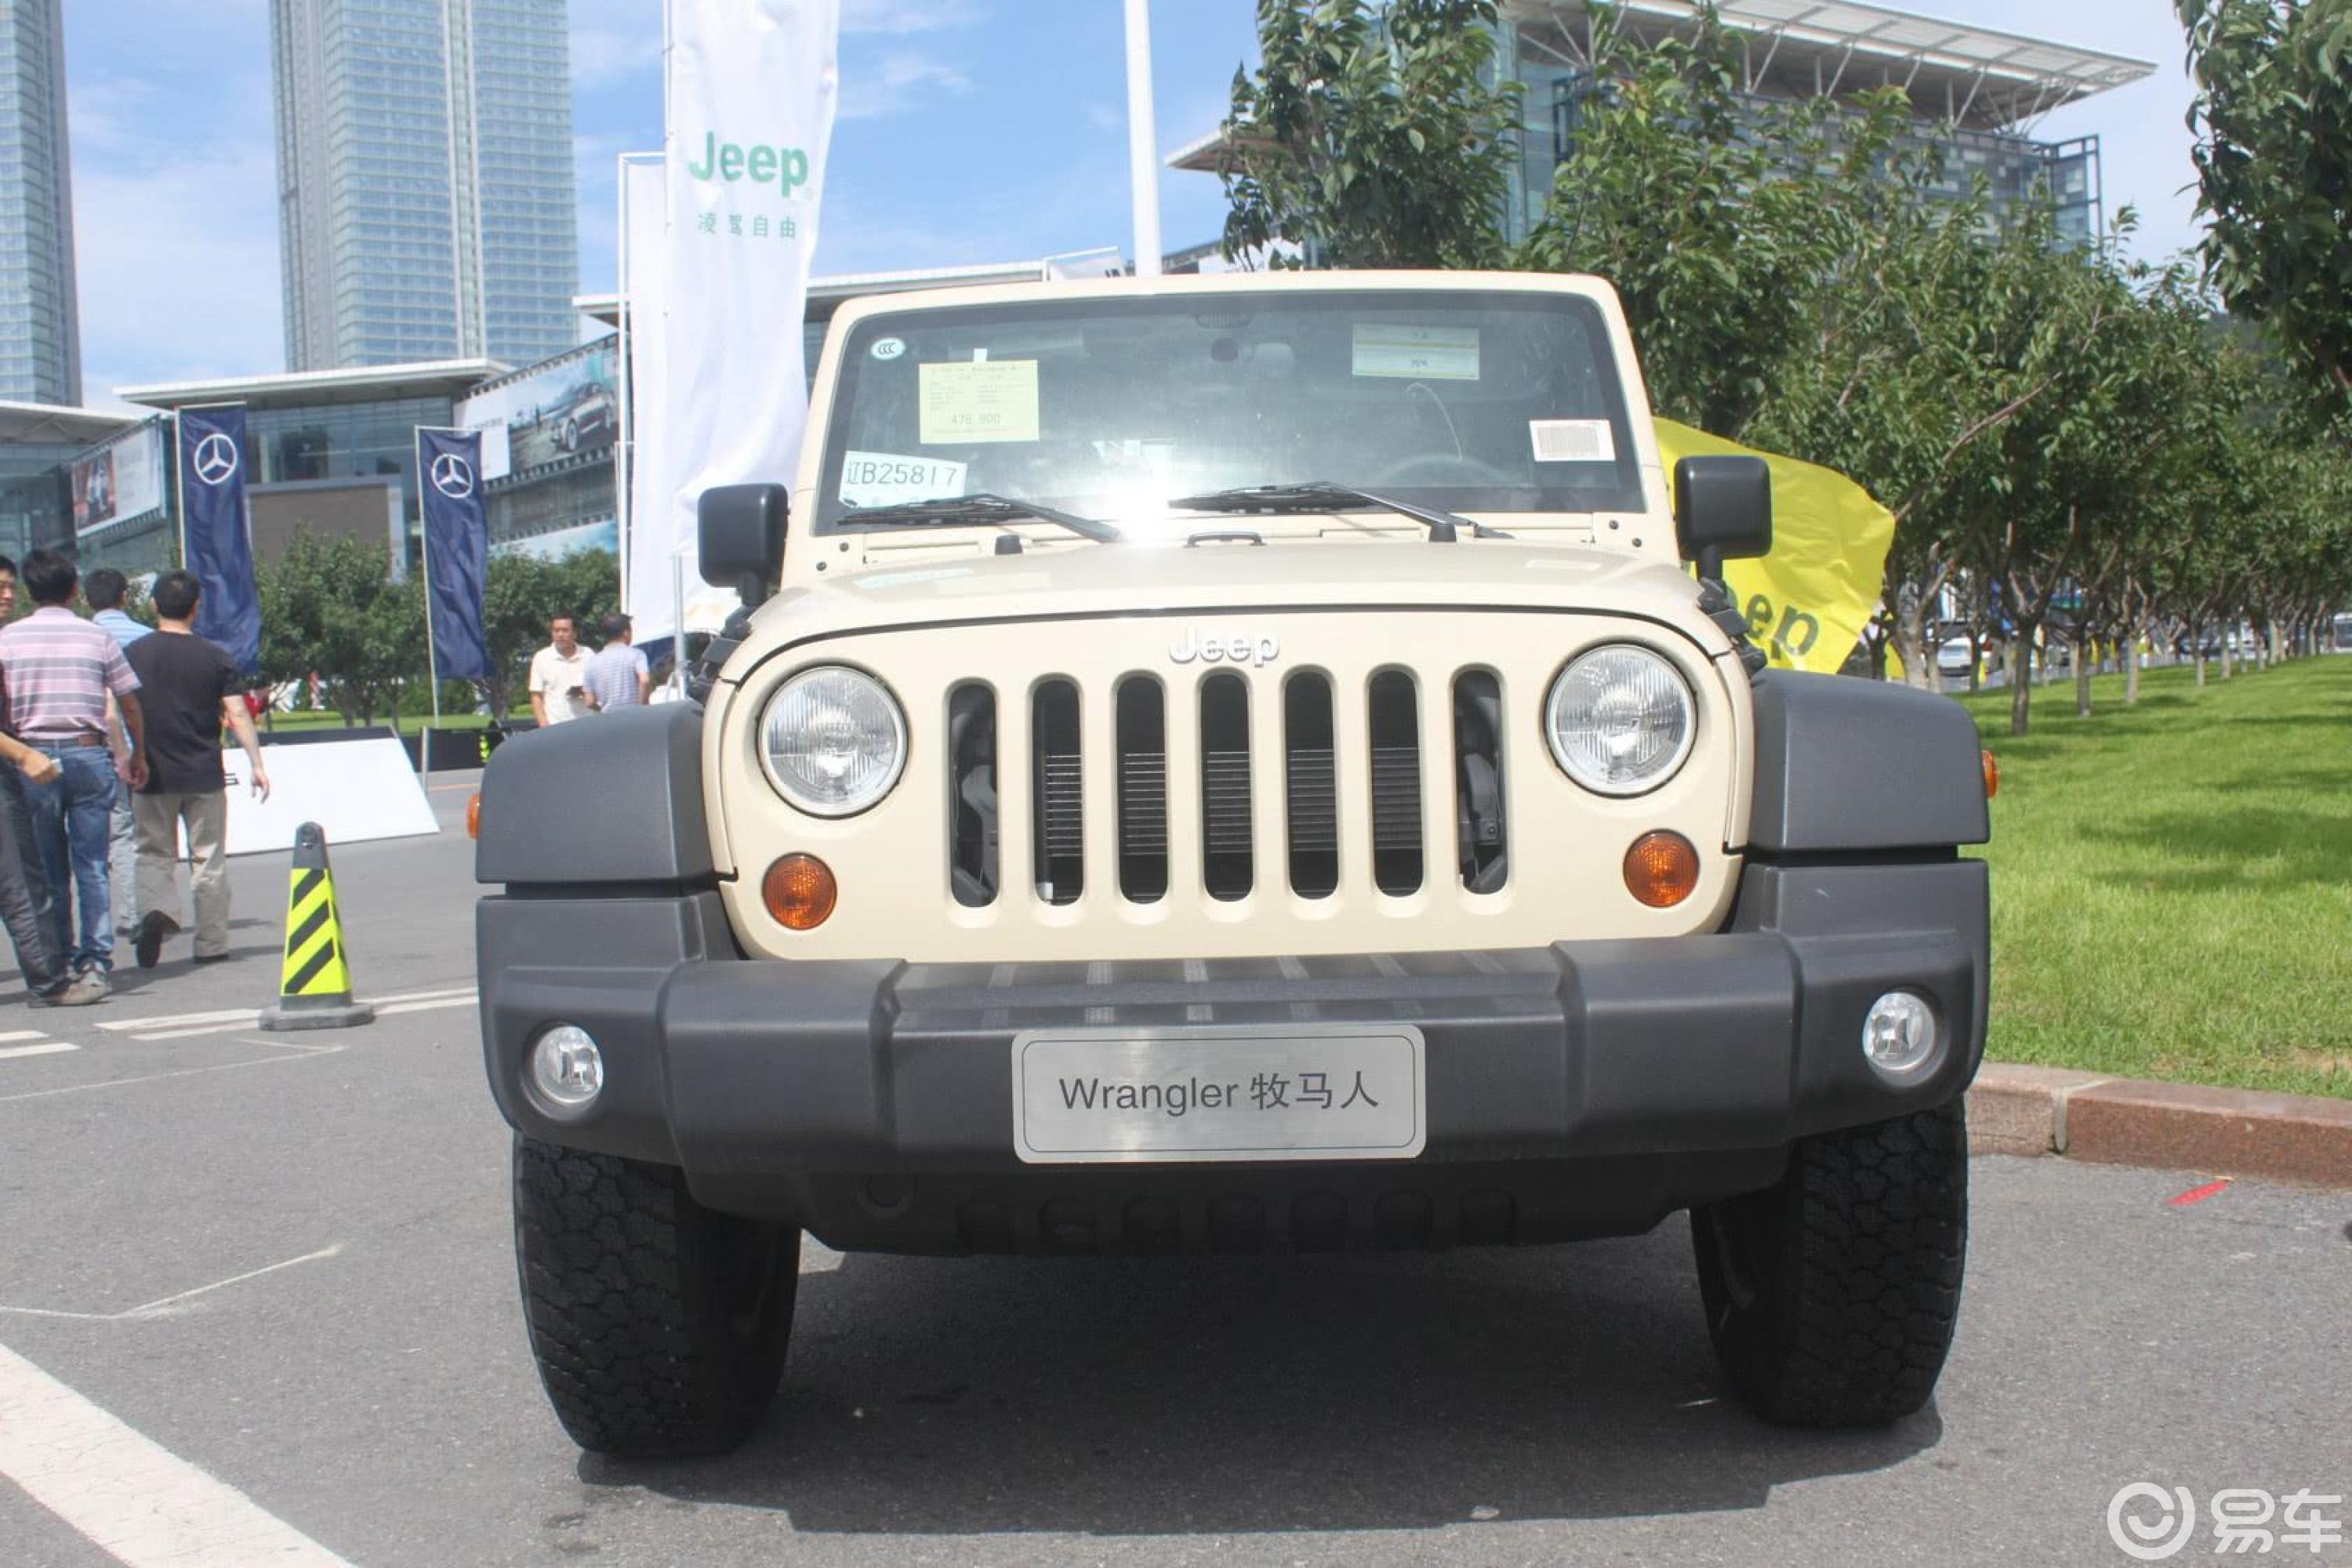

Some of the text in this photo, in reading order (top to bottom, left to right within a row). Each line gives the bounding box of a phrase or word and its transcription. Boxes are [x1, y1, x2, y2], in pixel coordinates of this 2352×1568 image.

[688, 131, 808, 198] Jeep
[1169, 624, 1280, 668] Jeep
[1058, 1070, 1379, 1117] Wrangler 牧马人
